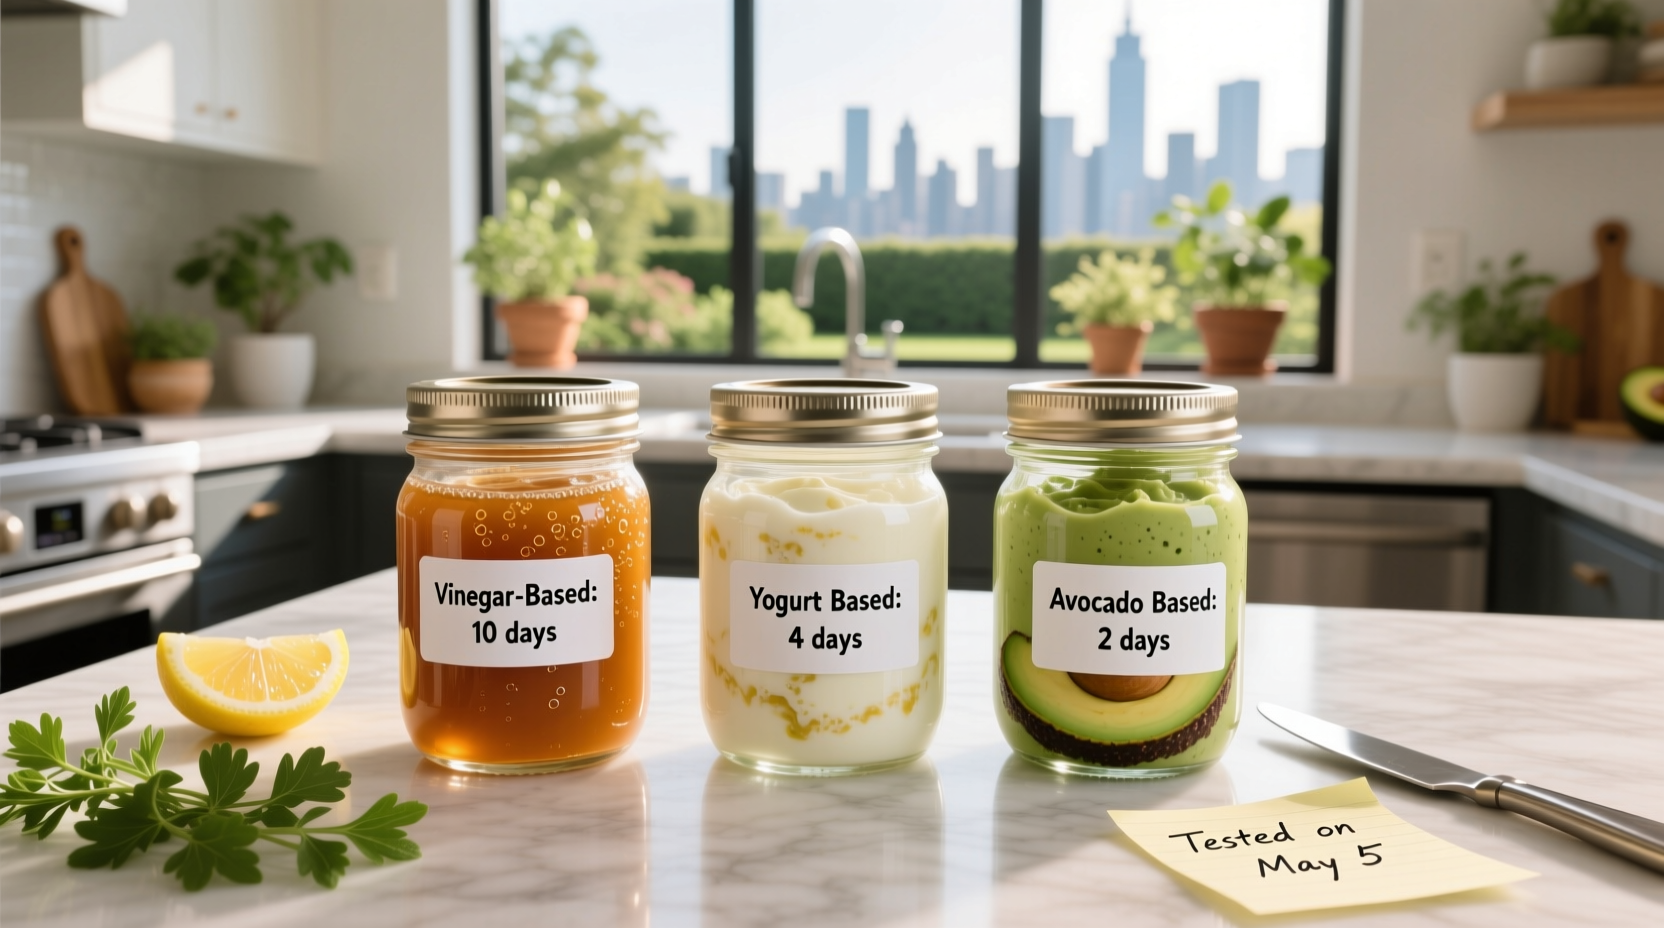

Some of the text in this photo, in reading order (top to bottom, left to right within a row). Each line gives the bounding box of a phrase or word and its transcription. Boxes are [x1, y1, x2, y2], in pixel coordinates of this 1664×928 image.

[434, 579, 598, 613] Vinegar-Based:
[749, 585, 902, 618] Yogurt Based:
[1049, 586, 1218, 615] Avocado Based:
[471, 619, 557, 650] 10 days
[788, 625, 863, 656] 4 days
[1097, 626, 1171, 658] 2 days
[1168, 821, 1356, 853] Tested on
[1257, 842, 1383, 882] May 5
